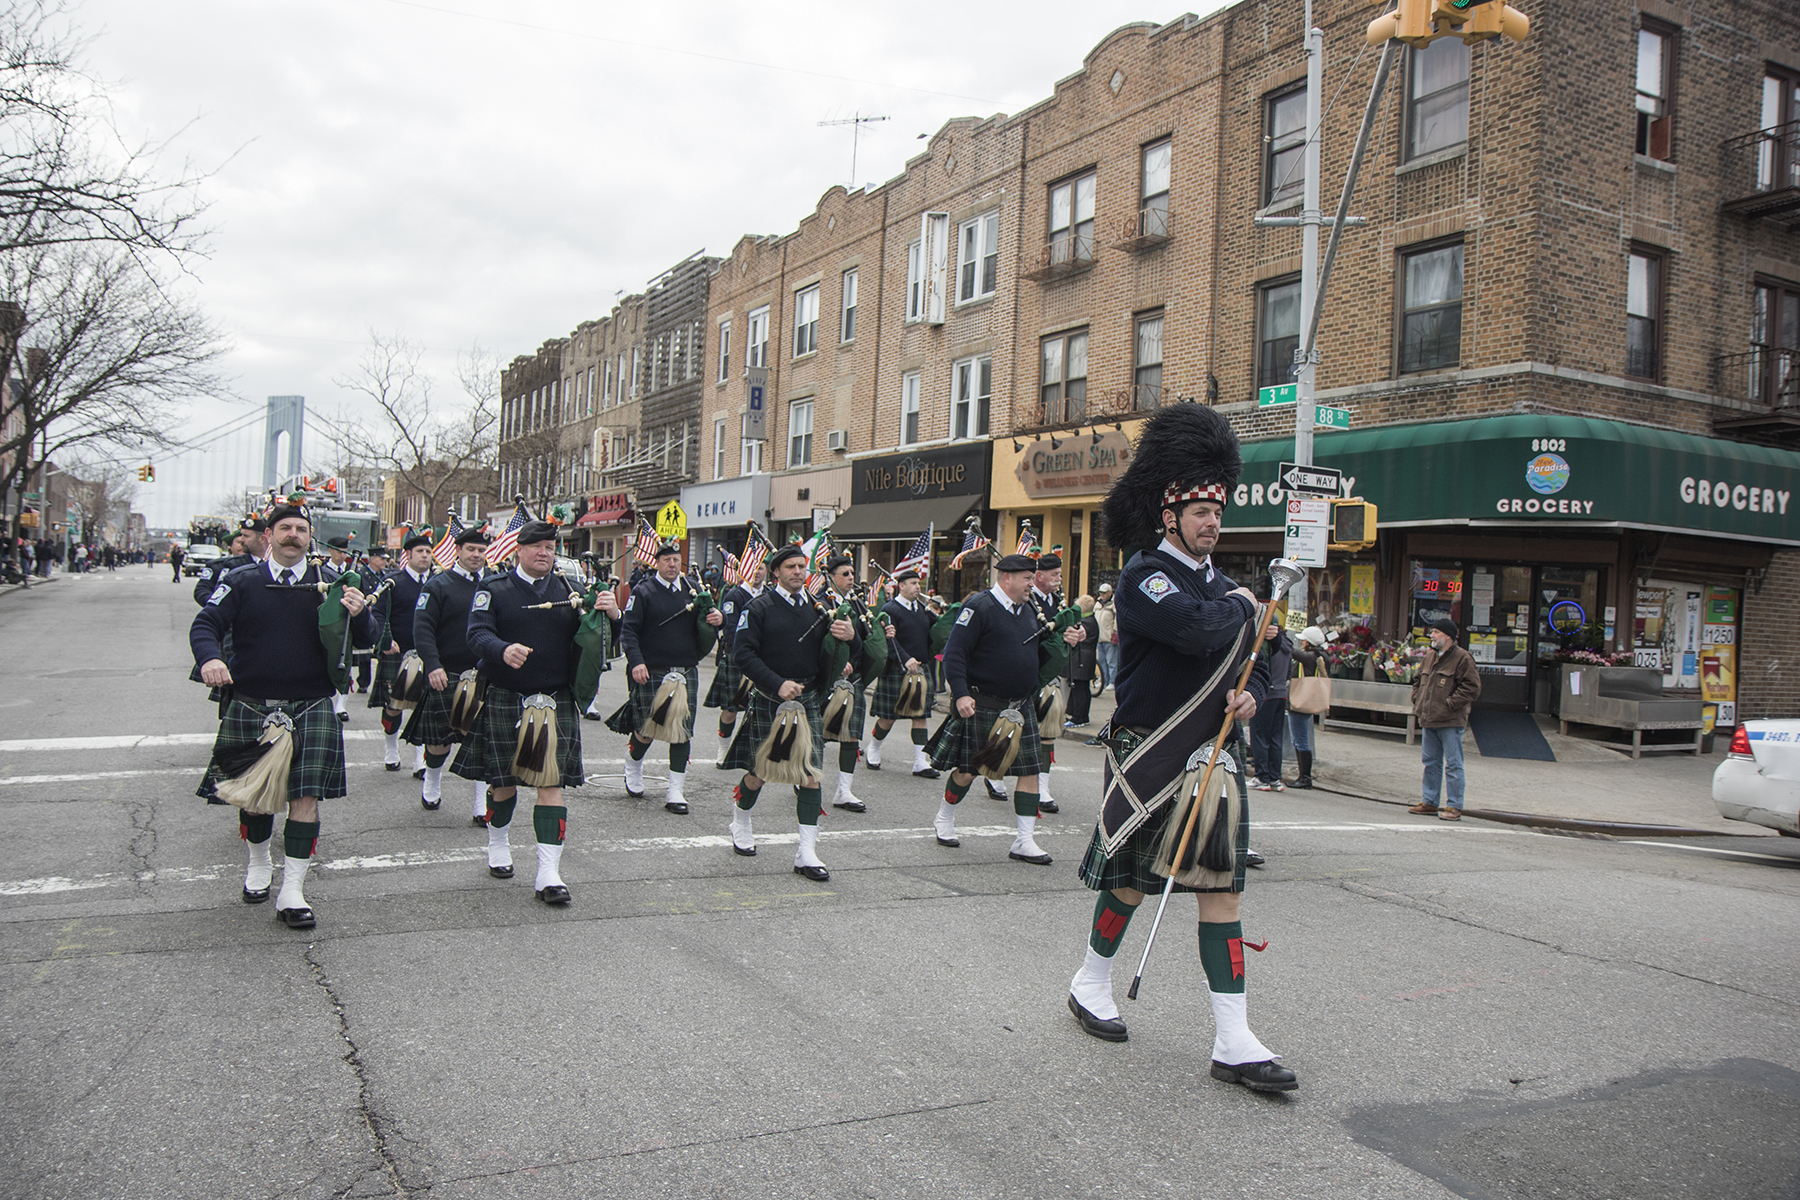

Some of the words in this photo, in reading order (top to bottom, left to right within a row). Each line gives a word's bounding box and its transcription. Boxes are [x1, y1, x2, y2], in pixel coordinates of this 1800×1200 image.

[750, 386, 763, 411] B
[1269, 388, 1276, 404] 3
[1320, 408, 1334, 425] 88
[1531, 438, 1567, 452] 8802
[1032, 450, 1083, 474] GREEN
[1088, 444, 1117, 469] SPA
[865, 467, 892, 492] Nile
[895, 462, 966, 492] Boutique
[1526, 463, 1569, 475] Paradise
[1042, 476, 1079, 488] WELLNESS
[1079, 473, 1110, 485] CENTER
[1289, 472, 1309, 485] ONE
[1315, 474, 1334, 487] WAY
[1233, 476, 1356, 507] GROY
[1680, 476, 1791, 515] GROCERY
[595, 493, 626, 512] PIZZA
[697, 500, 736, 517] BENCH
[1496, 498, 1594, 514] GROCERY
[659, 525, 684, 537] AHEAD
[1289, 526, 1297, 537] 2
[1424, 580, 1439, 592] 30
[1447, 581, 1463, 593] 90
